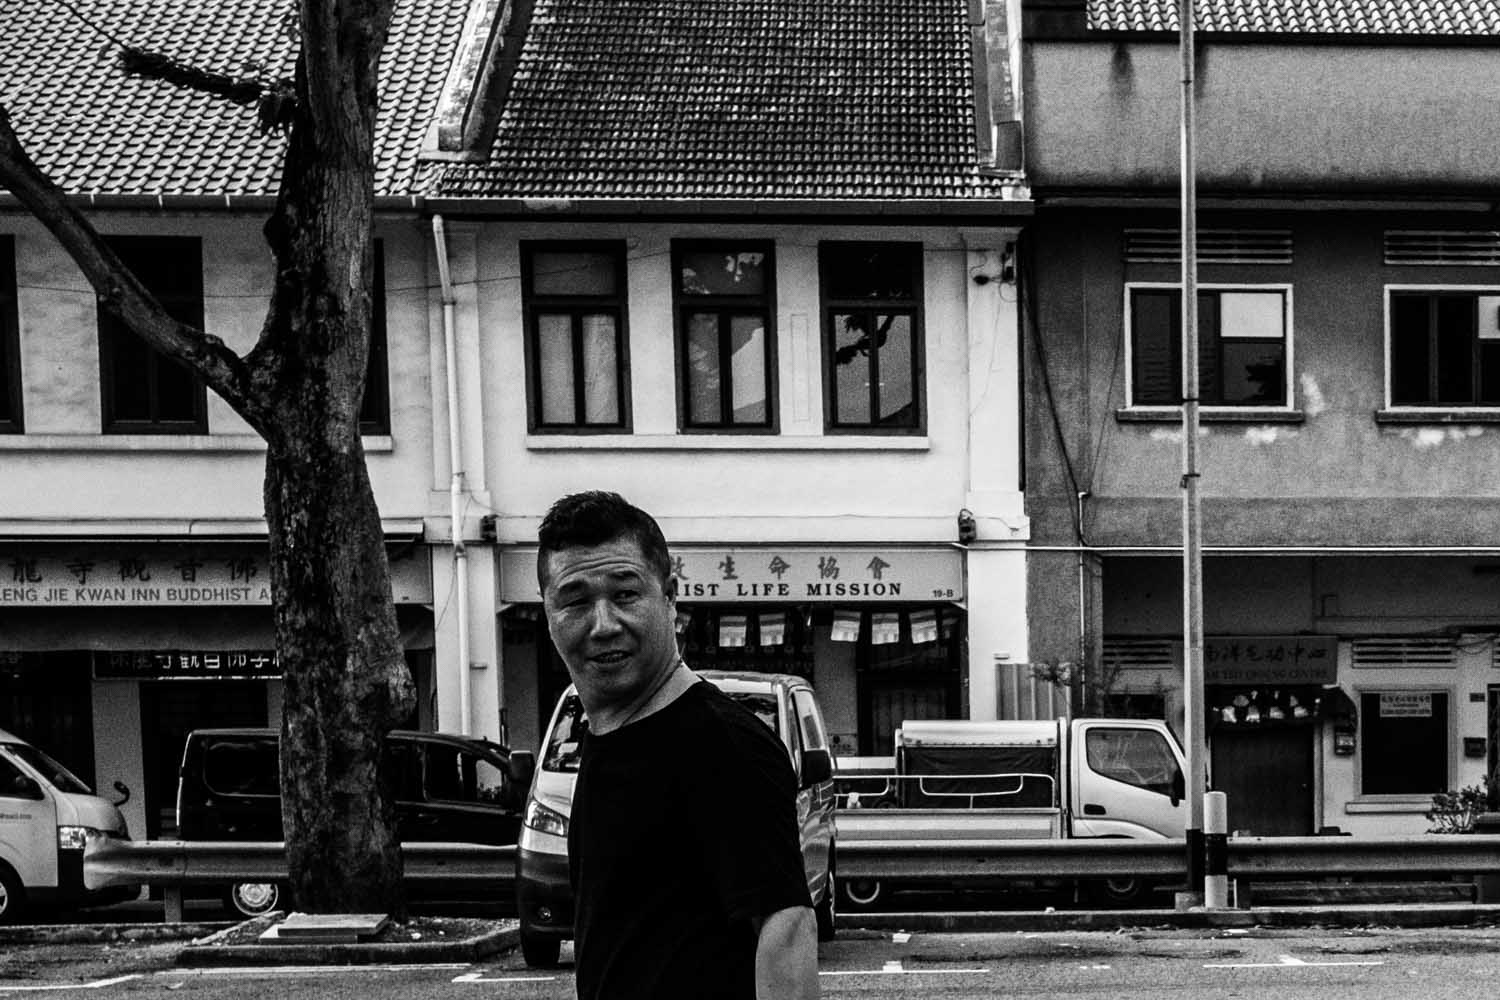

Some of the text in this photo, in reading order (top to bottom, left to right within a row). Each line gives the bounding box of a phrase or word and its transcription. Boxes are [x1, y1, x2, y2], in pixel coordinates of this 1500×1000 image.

[0, 587, 38, 602] ENG
[44, 587, 68, 602] JIE
[75, 587, 126, 602] KWAN
[132, 587, 161, 602] INN
[167, 587, 252, 602] BUDDHIST
[675, 583, 902, 597] IST LIFE MISSION
[932, 589, 954, 598] 19-B
